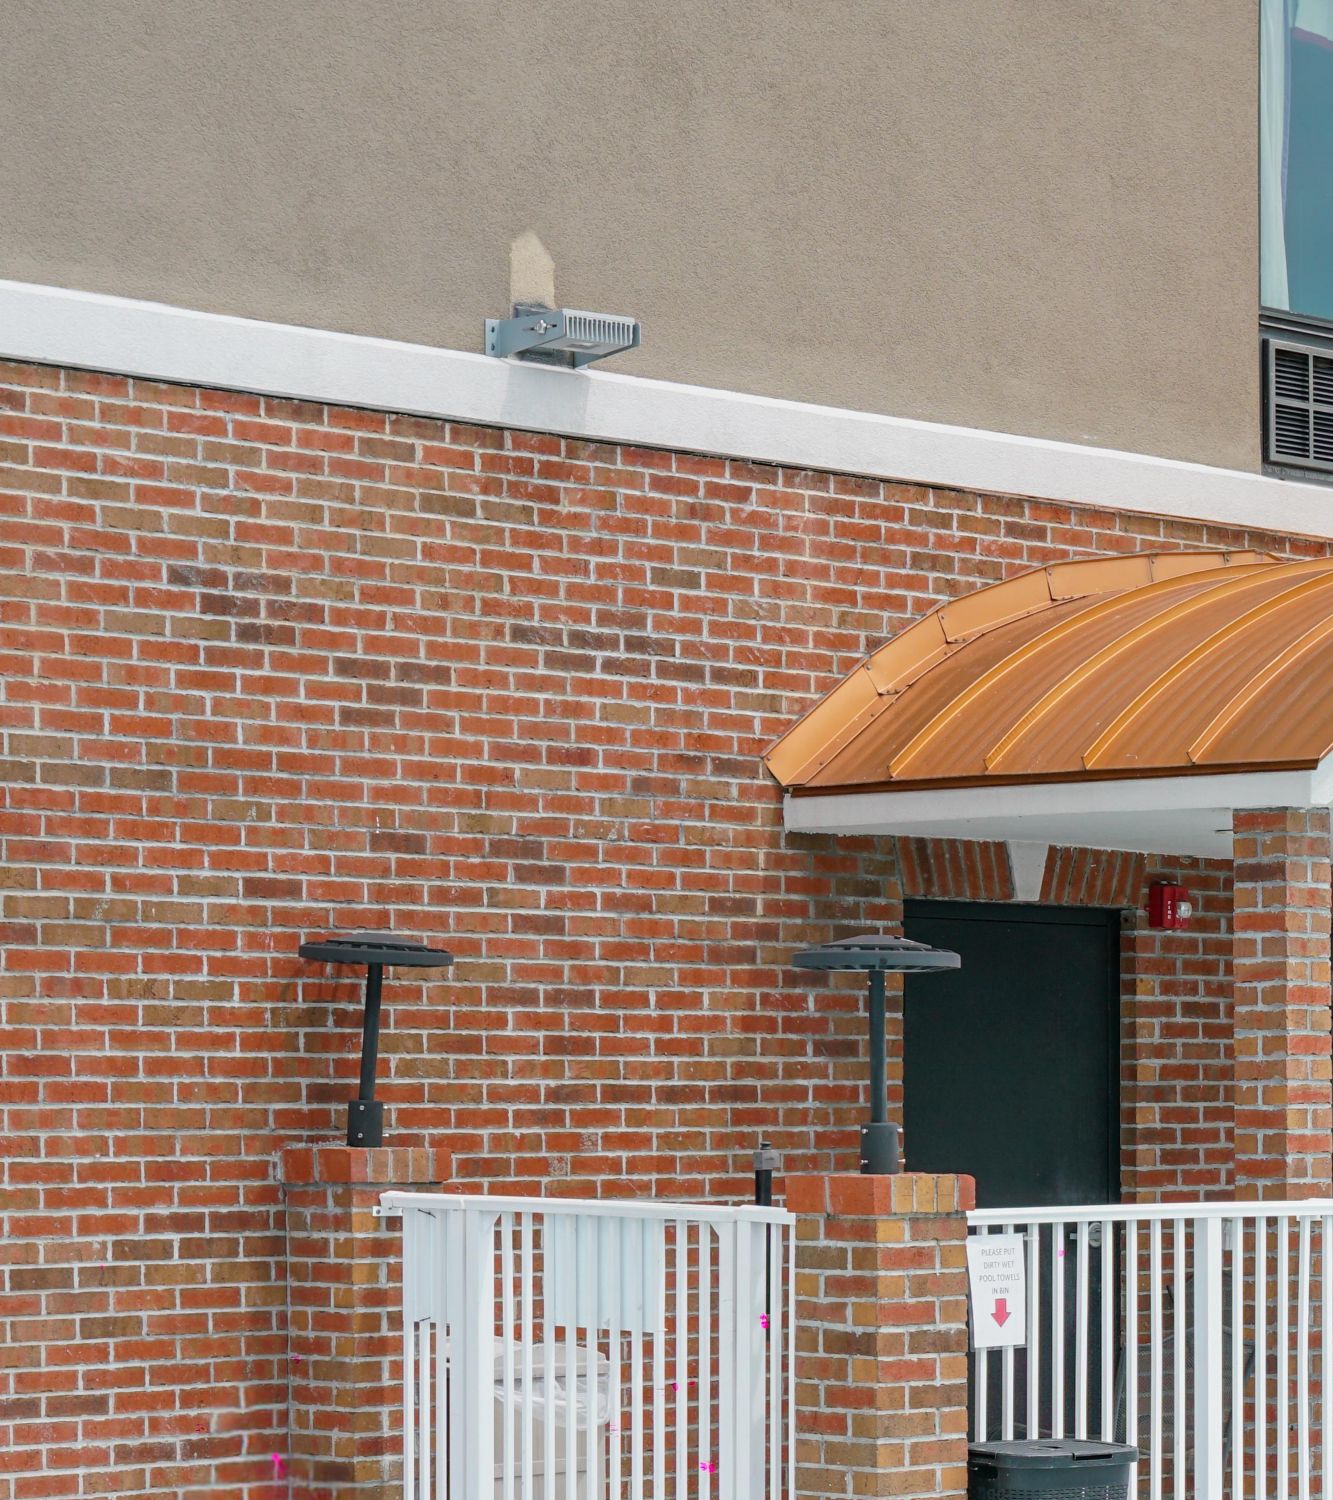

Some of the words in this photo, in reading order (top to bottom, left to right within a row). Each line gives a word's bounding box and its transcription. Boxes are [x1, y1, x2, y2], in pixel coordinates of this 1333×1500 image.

[981, 1248, 1003, 1256] PLEASE
[1003, 1247, 1015, 1255] PUT
[983, 1261, 1000, 1269] DIRTY
[1002, 1260, 1014, 1268] WET
[979, 1274, 996, 1282] POOL
[997, 1273, 1020, 1281] TOWELS
[992, 1287, 998, 1295] IN
